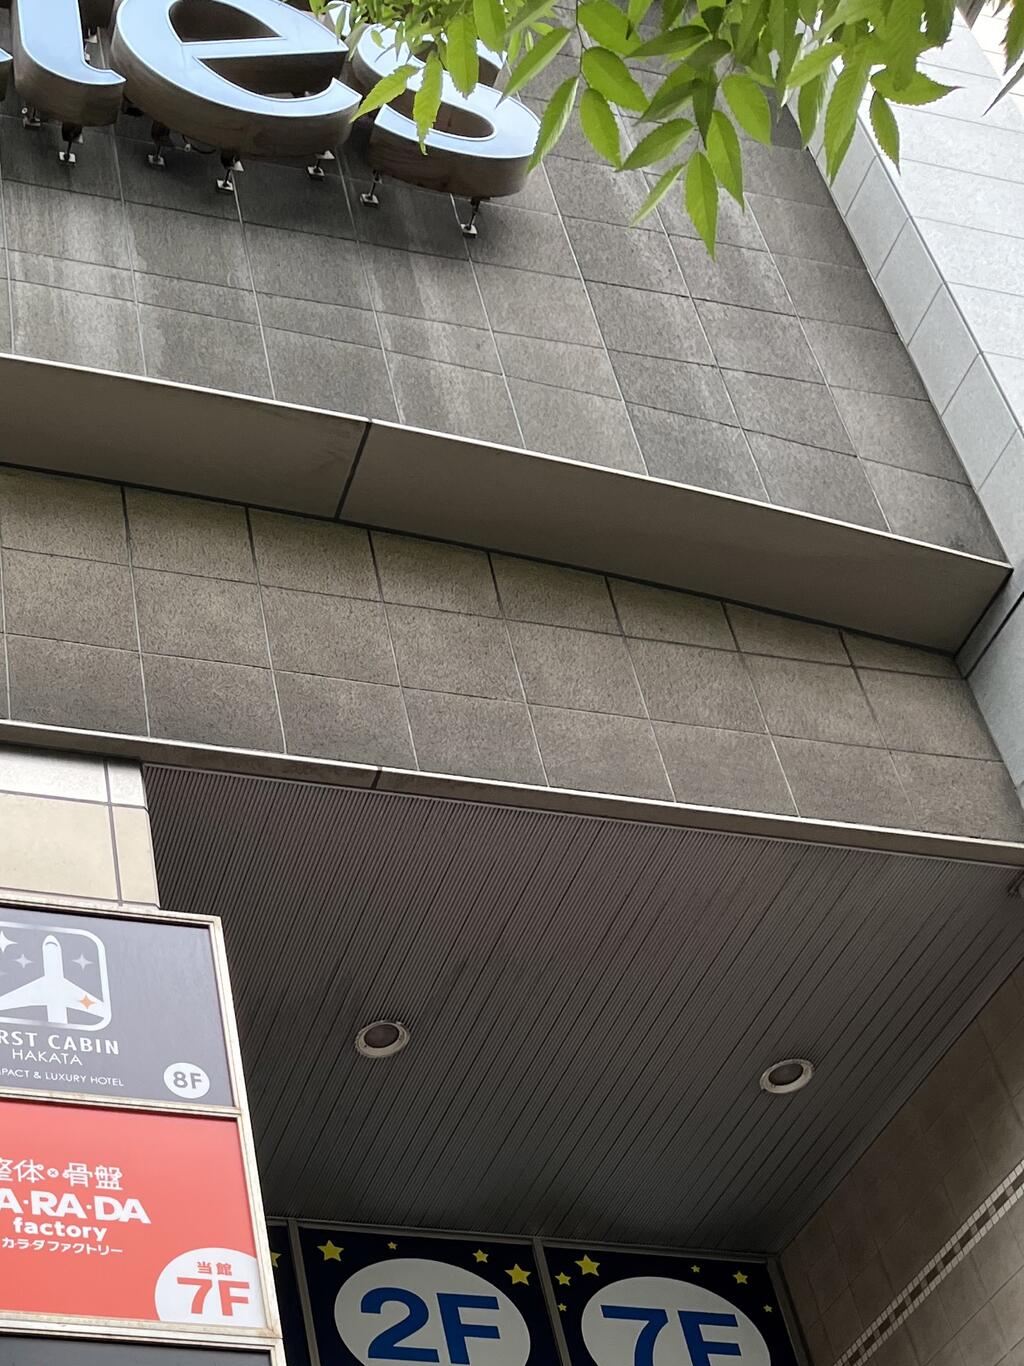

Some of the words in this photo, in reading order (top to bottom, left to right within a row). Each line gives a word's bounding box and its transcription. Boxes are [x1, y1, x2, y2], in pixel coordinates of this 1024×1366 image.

[47, 1034, 120, 1055] CABIN
[12, 1048, 83, 1066] HAKATA
[33, 1071, 41, 1079] &
[45, 1072, 87, 1083] LUXURY
[90, 1076, 124, 1087] HOTEL
[173, 1071, 202, 1089] 8F
[12, 1216, 107, 1241] factory
[197, 1261, 233, 1276] 当館
[177, 1276, 250, 1316] 7F
[359, 1286, 502, 1365] 2F
